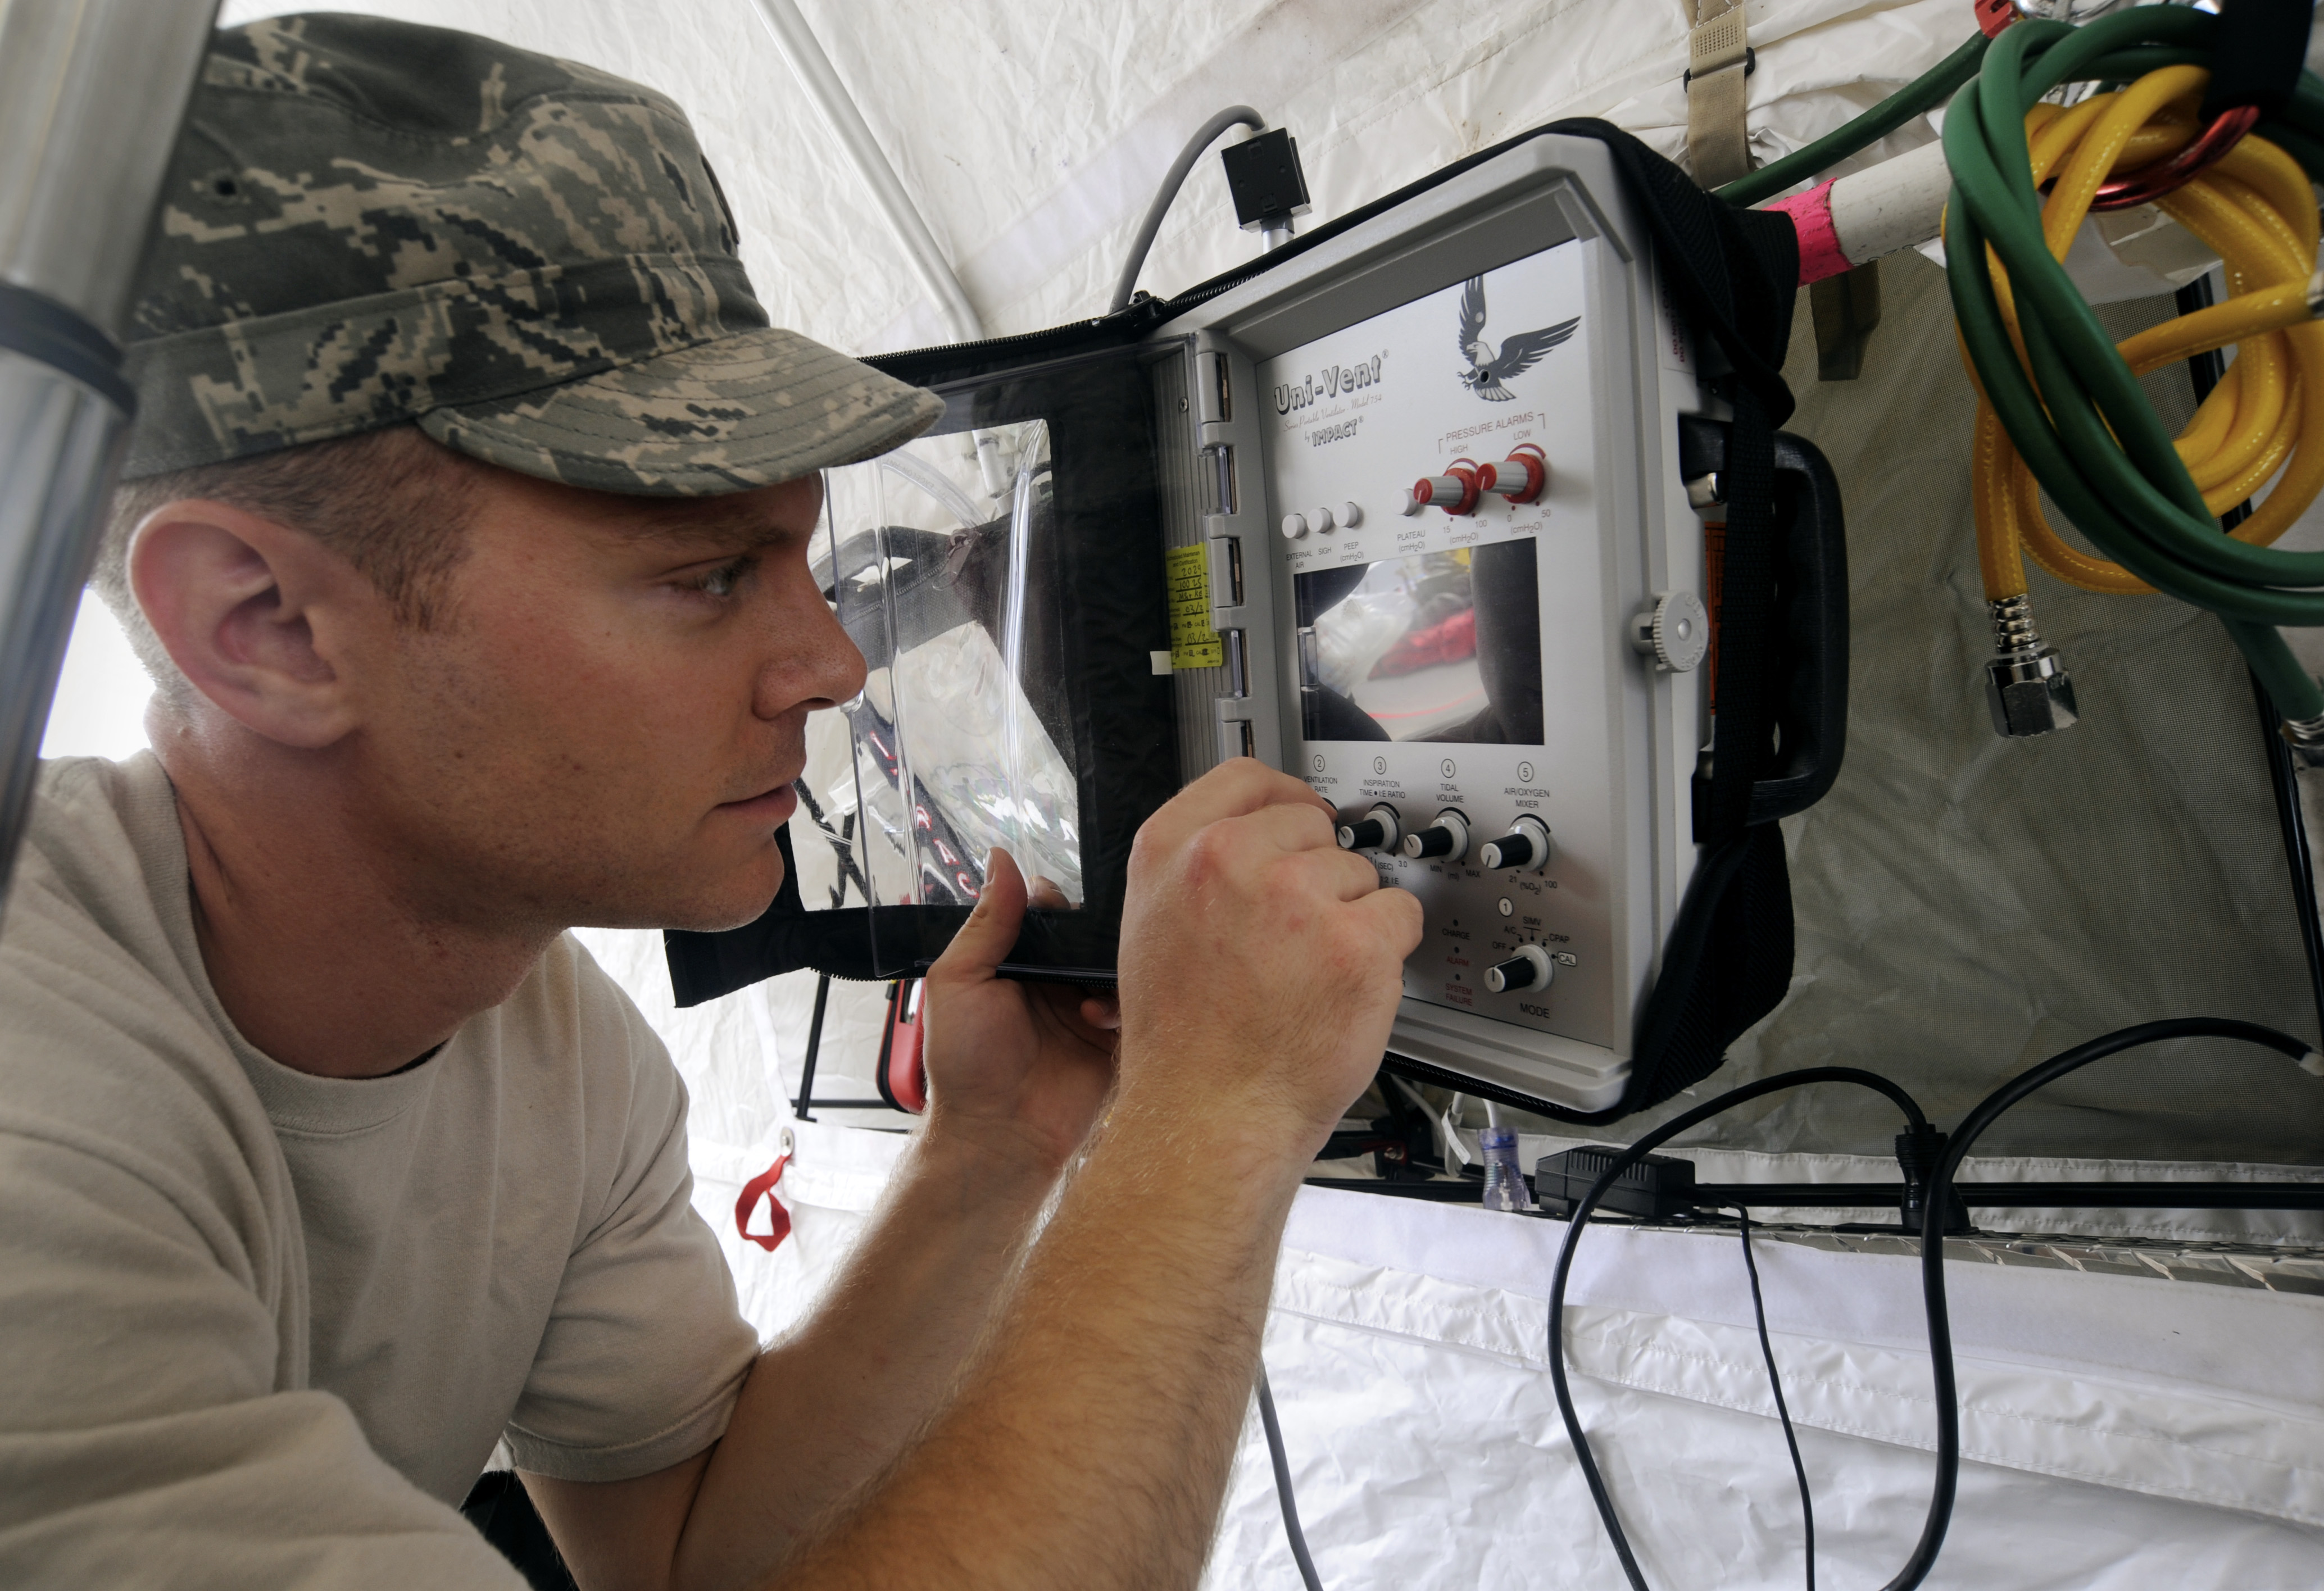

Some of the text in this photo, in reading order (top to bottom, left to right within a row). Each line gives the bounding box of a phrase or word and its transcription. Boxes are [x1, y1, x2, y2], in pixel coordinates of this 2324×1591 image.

[1274, 354, 1381, 416] Uni-Vent
[1283, 393, 1383, 432] Series Portable Ventilator Model 754
[1304, 418, 1358, 447] by IMPACT
[1446, 411, 1534, 442] PRESSURE ALARMS
[1513, 428, 1531, 440] LOW
[1450, 443, 1468, 455] HIGH
[1506, 508, 1551, 523] 0 50
[1443, 519, 1488, 534] 15 100
[1397, 530, 1426, 542] PLATEAU
[1318, 546, 1332, 555] SIGH
[1343, 541, 1359, 551] PEEP
[1286, 549, 1313, 561] EXTERNAL
[1304, 775, 1338, 784] VENTILATION
[1363, 779, 1400, 788] INSPIRATION
[1359, 788, 1373, 797] TIME
[1440, 783, 1459, 792] TIDAL
[1436, 793, 1464, 803] VOLUME
[1515, 799, 1539, 809] MIXER
[1378, 862, 1394, 872] (SEC)
[1429, 863, 1481, 882] MIN (ml) MAX
[1508, 875, 1517, 883] 21
[1545, 880, 1558, 889] 100
[1523, 916, 1542, 926] SIMV
[1442, 928, 1470, 940] CHARGE
[1504, 926, 1517, 935] A/C
[1549, 933, 1570, 944] CPAP
[1492, 941, 1507, 951] OFF
[1446, 956, 1469, 967] ALARM
[1559, 953, 1576, 965] CAL
[1445, 983, 1473, 996] SYSTEM
[1445, 993, 1473, 1007] FAILURE
[1520, 1002, 1550, 1019] MODE
